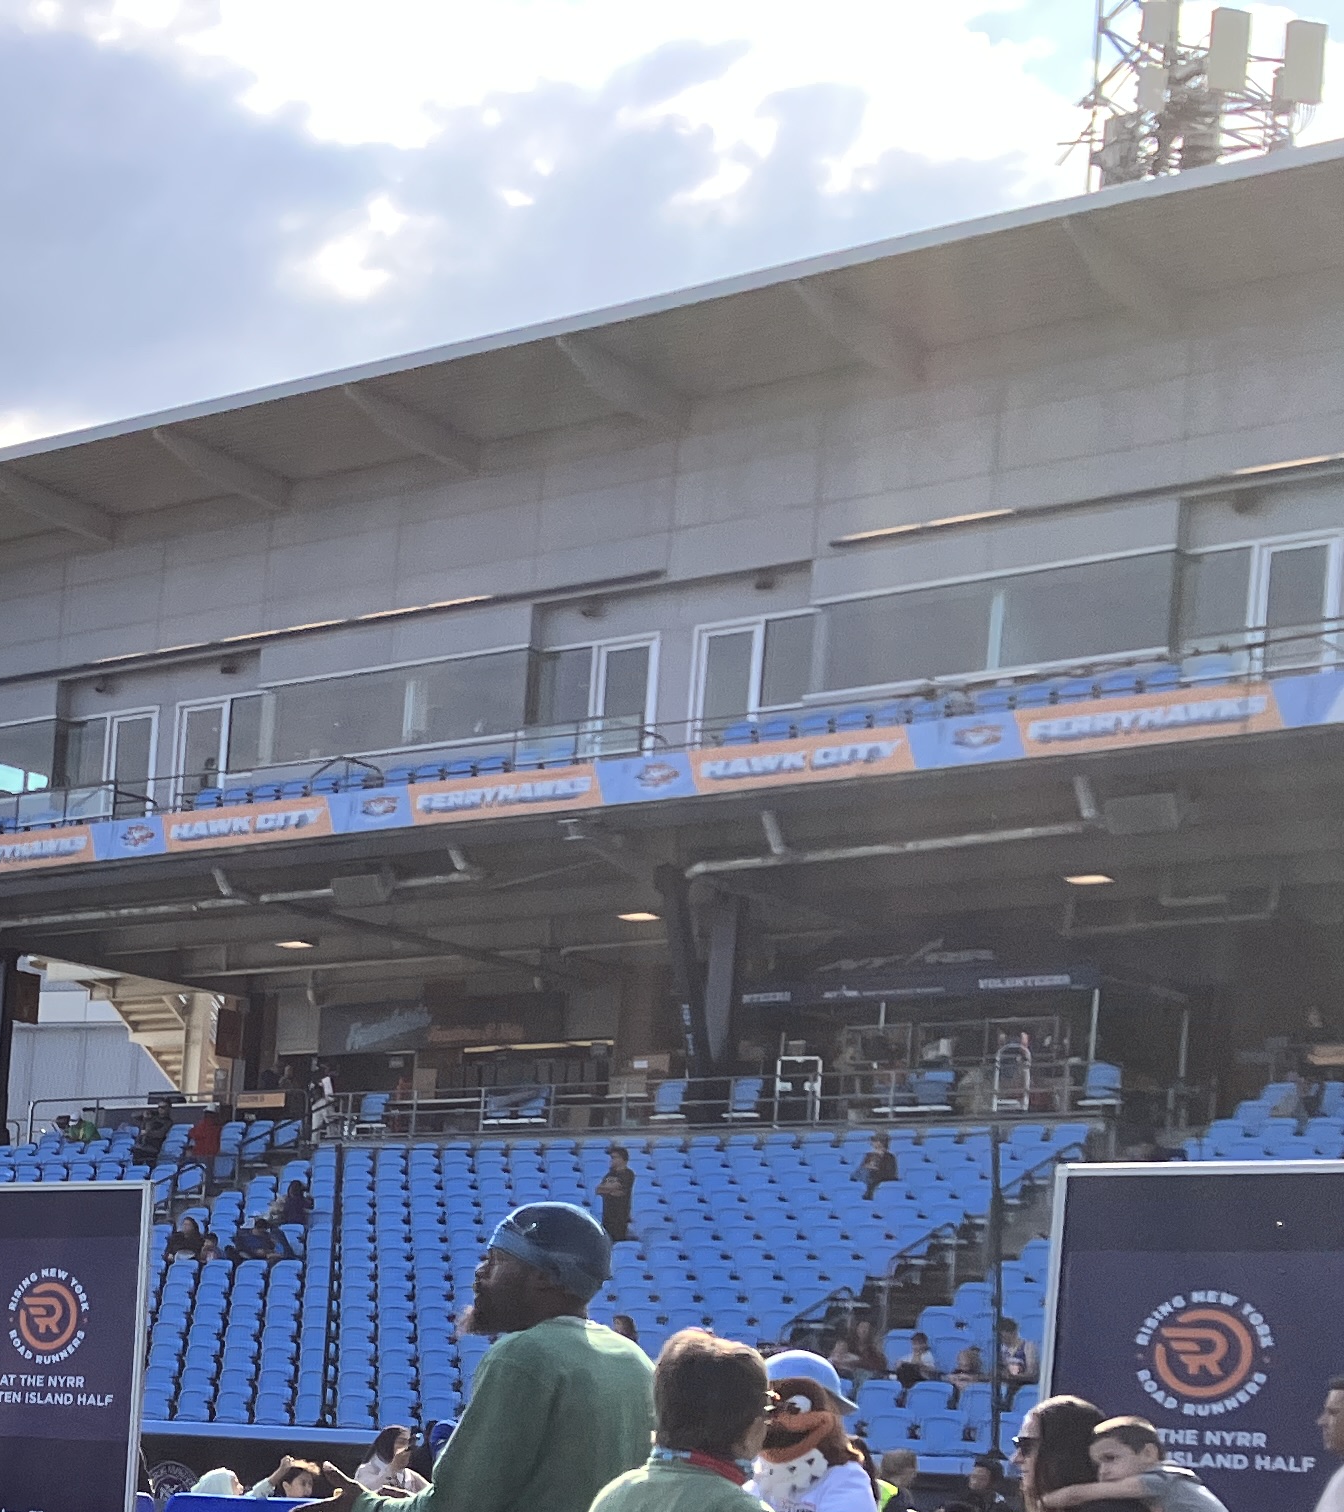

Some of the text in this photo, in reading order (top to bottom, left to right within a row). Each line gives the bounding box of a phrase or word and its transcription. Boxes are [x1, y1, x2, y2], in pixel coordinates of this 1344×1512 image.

[700, 752, 807, 780] HAWK
[170, 807, 326, 841] HAWK CITY
[8, 1268, 90, 1313] RISING NEW YORK
[1191, 1290, 1240, 1306] NEW
[1242, 1303, 1275, 1349] YORK
[8, 1329, 85, 1364] ROAD RUNNERS
[0, 1374, 85, 1388] AT THE NYRR
[1137, 1369, 1178, 1409] ROAD
[25, 1392, 74, 1405] ISLAND
[77, 1394, 114, 1407] HALF
[1158, 1428, 1267, 1448] THE NYRR
[1165, 1451, 1316, 1473] ISLAND HALF
